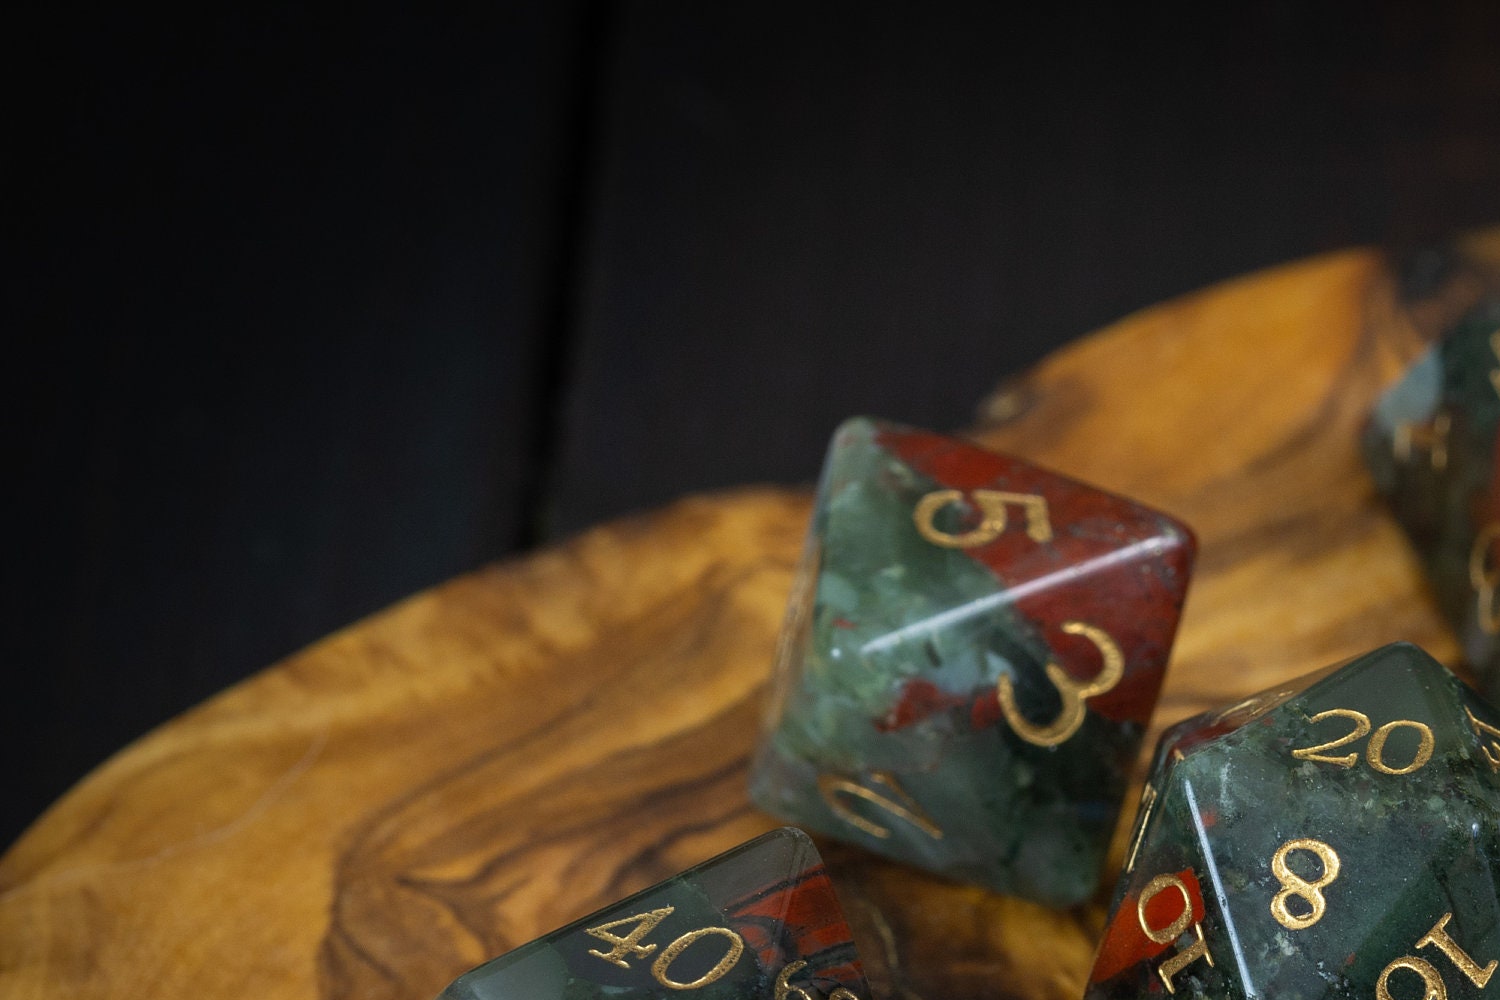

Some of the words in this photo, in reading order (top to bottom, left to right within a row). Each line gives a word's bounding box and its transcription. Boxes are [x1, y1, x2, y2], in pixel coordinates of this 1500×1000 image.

[913, 490, 1053, 549] 5
[999, 621, 1126, 748] 3
[1291, 708, 1436, 776] 20
[1270, 838, 1342, 931] 8
[585, 905, 745, 991] 40
[1137, 872, 1216, 996] 10
